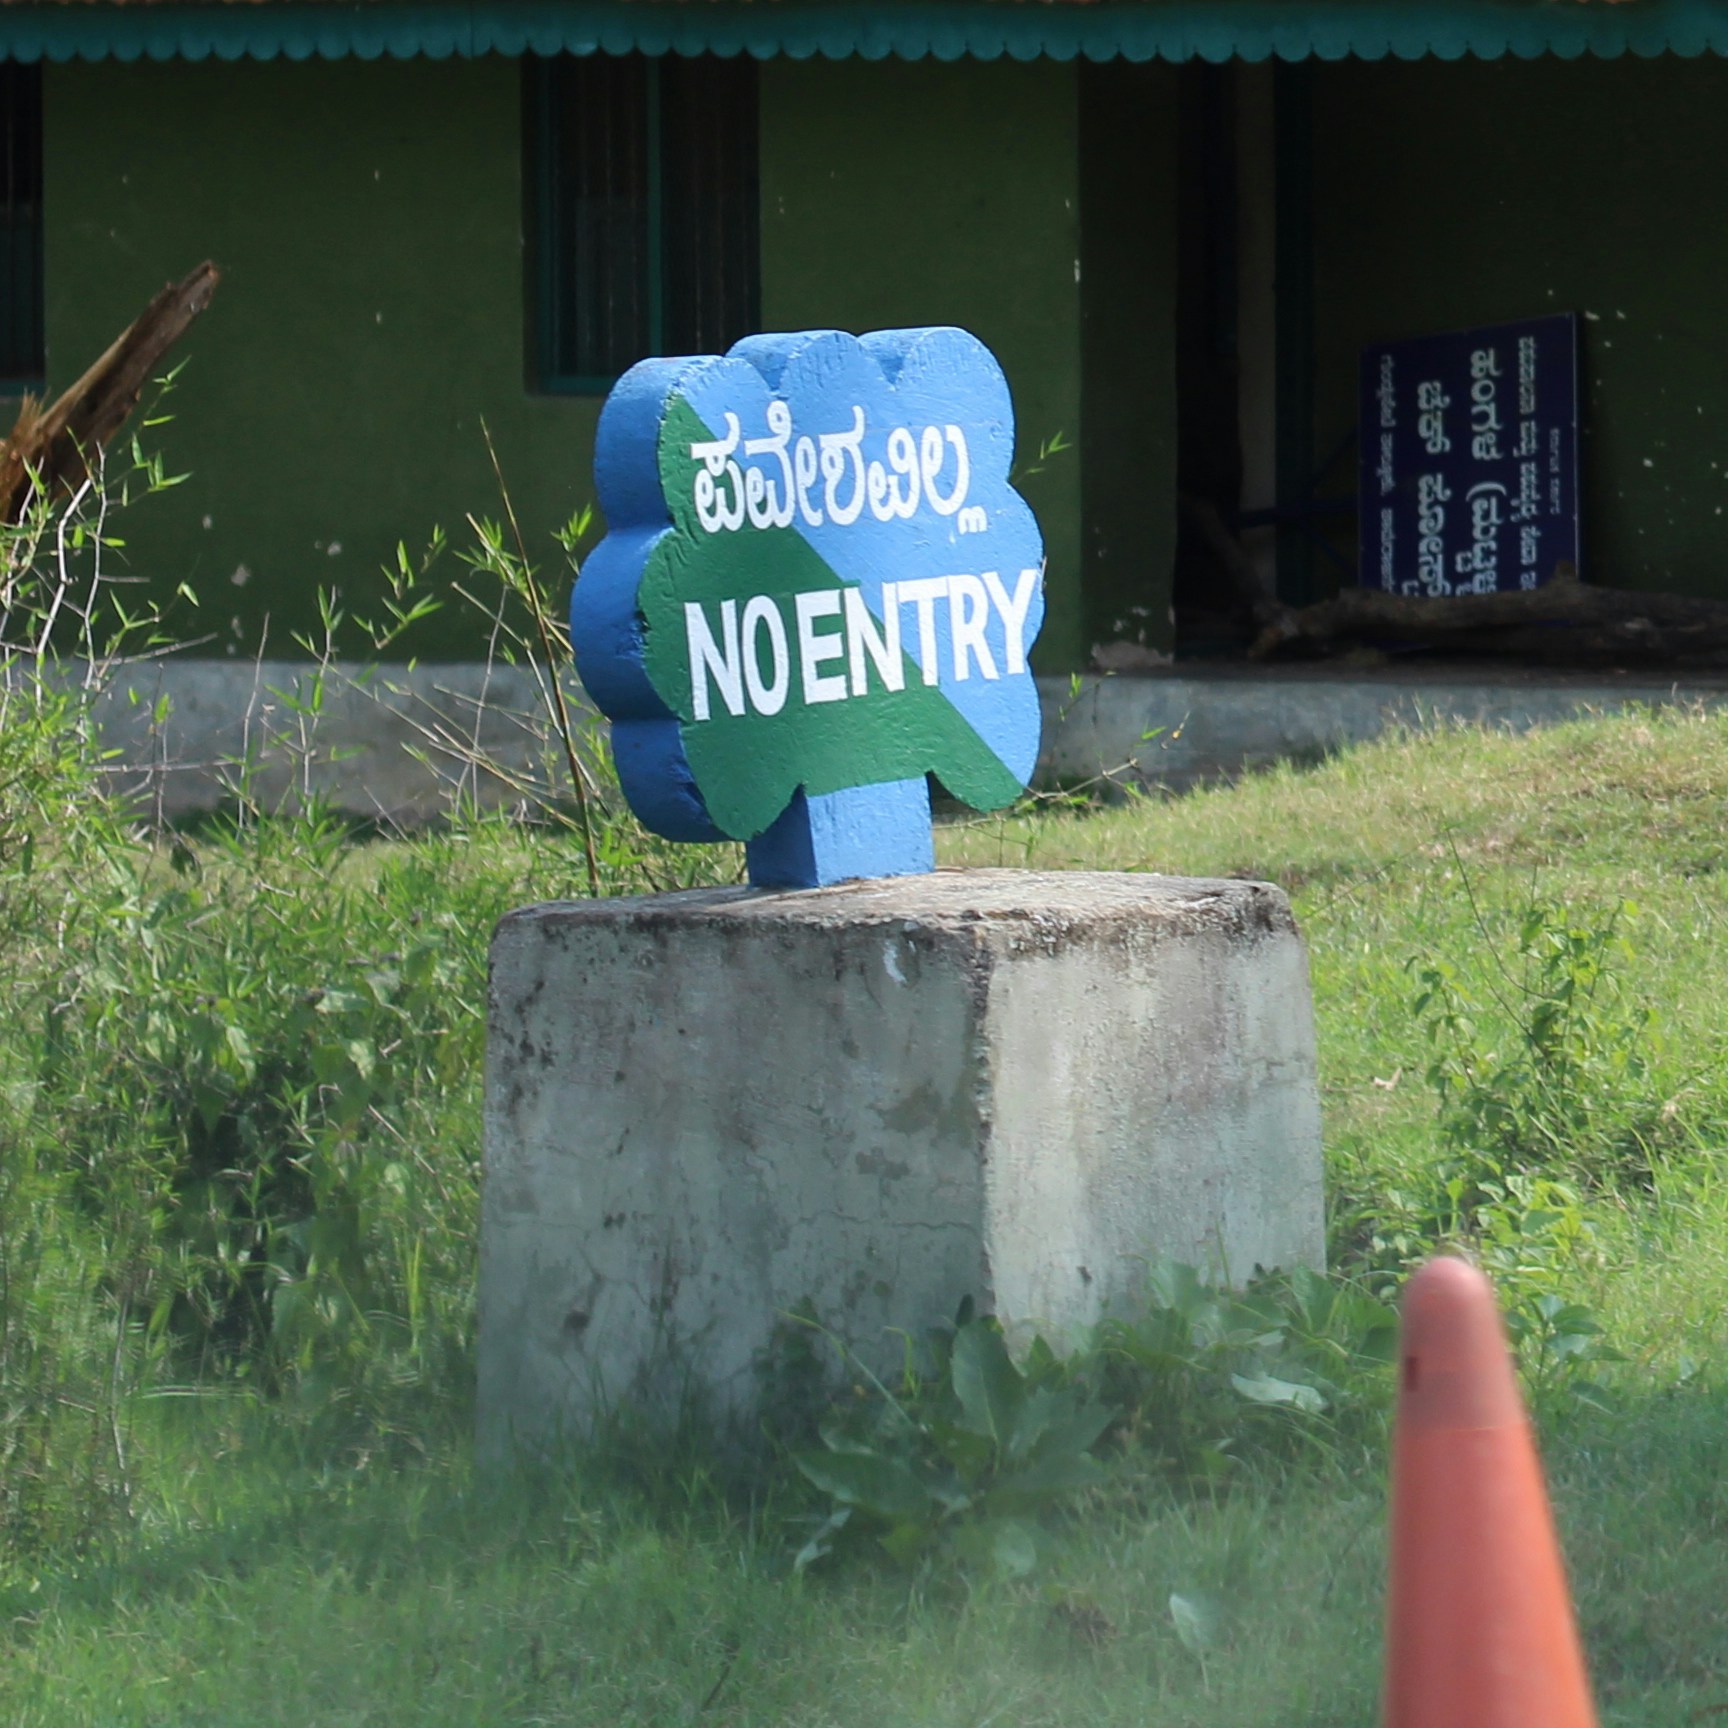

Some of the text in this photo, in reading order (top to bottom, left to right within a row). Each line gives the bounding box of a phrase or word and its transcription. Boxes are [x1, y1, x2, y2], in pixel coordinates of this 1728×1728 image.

[1470, 348, 1505, 461] ಹಂಗಳ
[682, 568, 1039, 721] NO ENTRY
